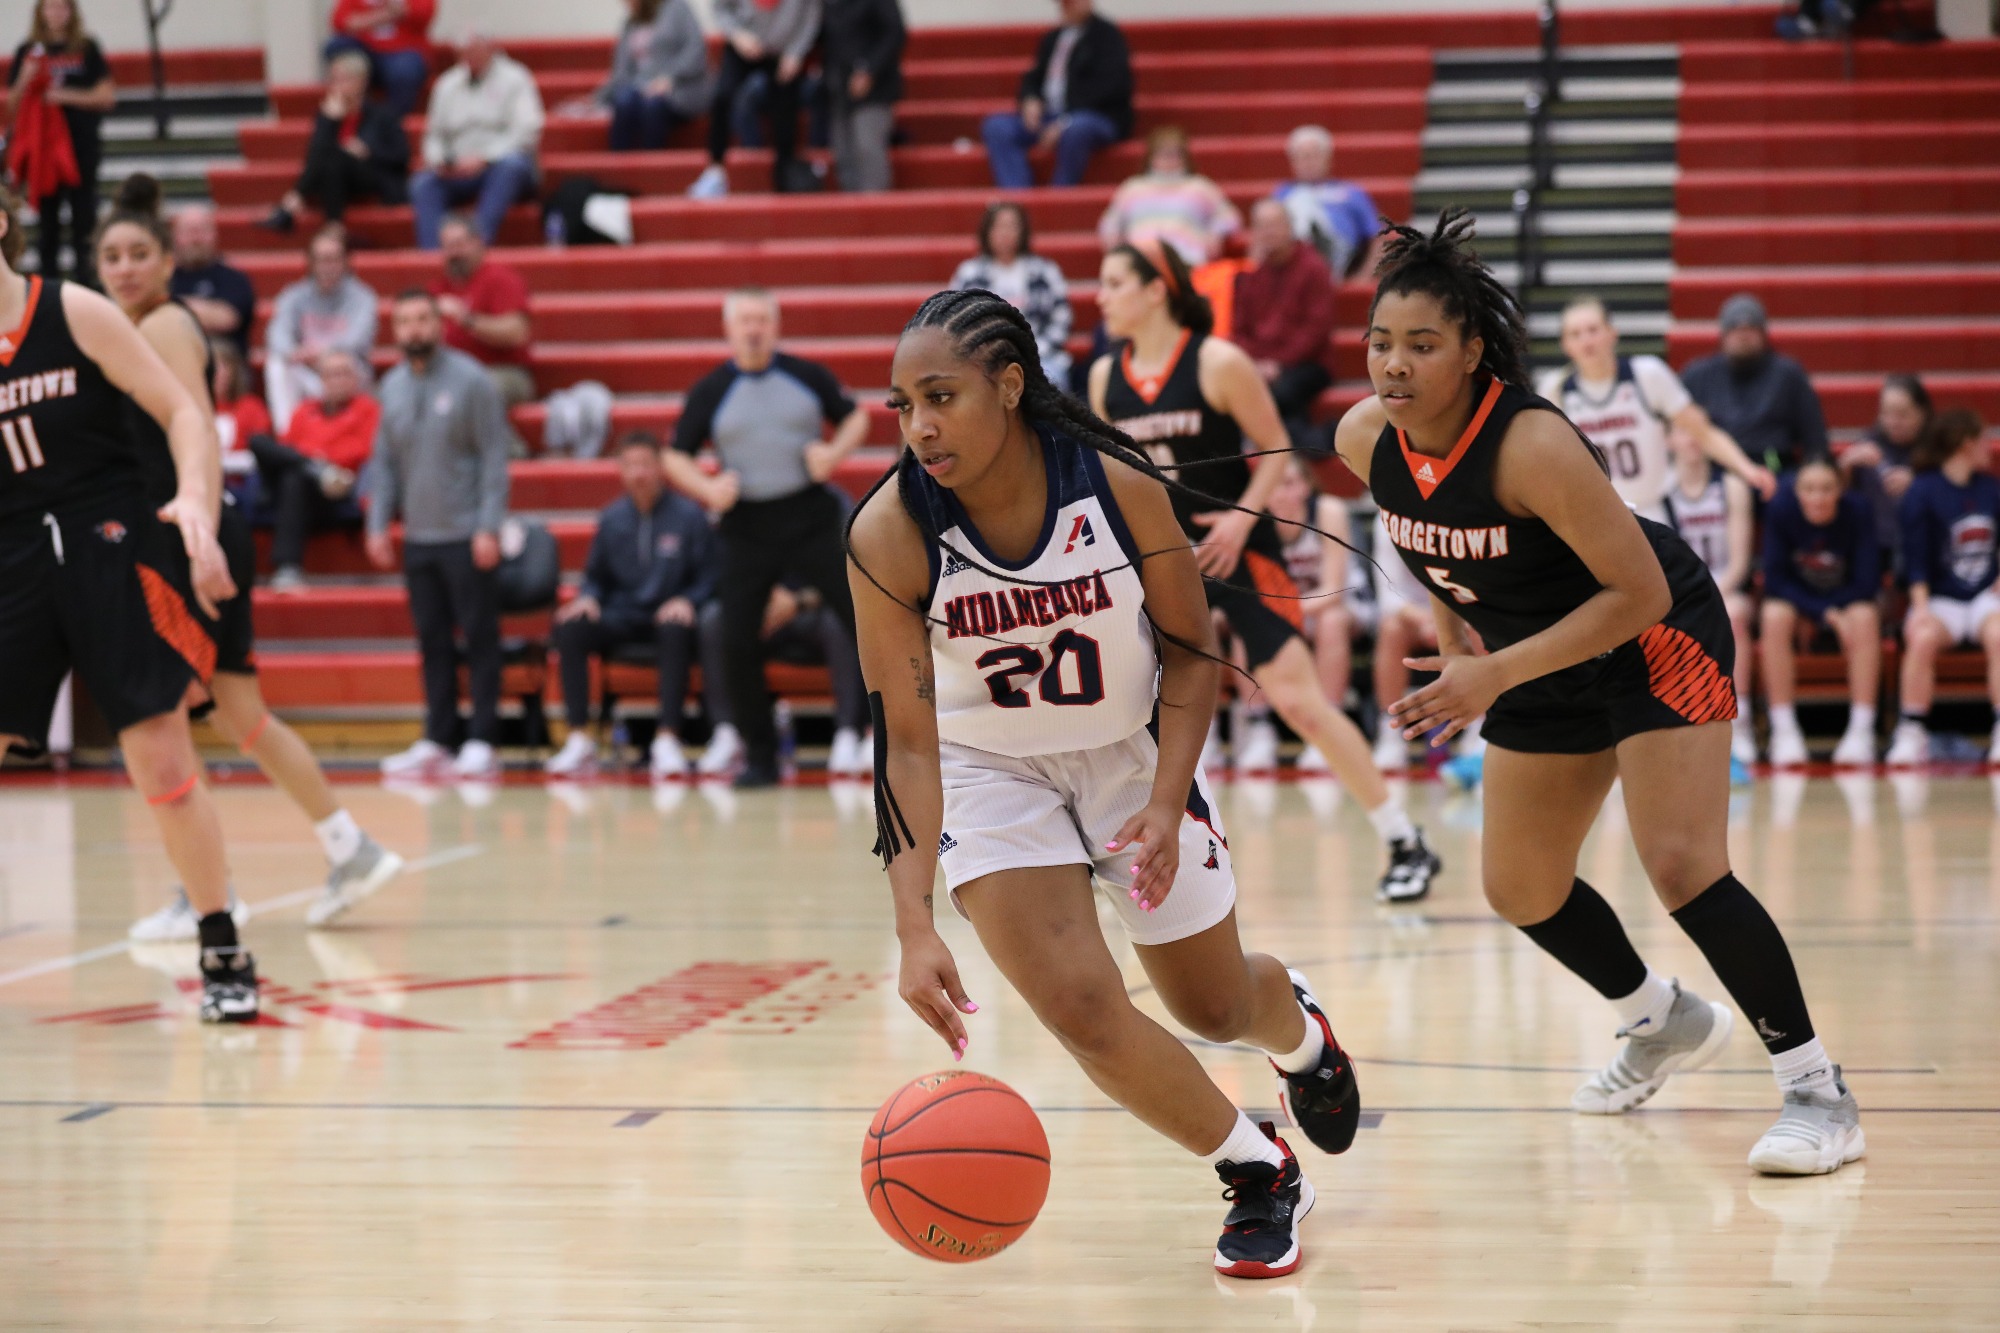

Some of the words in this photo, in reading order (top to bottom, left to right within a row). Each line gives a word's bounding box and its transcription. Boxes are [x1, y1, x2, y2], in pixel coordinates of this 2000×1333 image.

[0, 413, 46, 475] 11
[1376, 506, 1509, 561] EORGETOWN
[944, 569, 1113, 640] MIDAMERICA
[1424, 565, 1479, 605] 5
[975, 627, 1106, 708] 20
